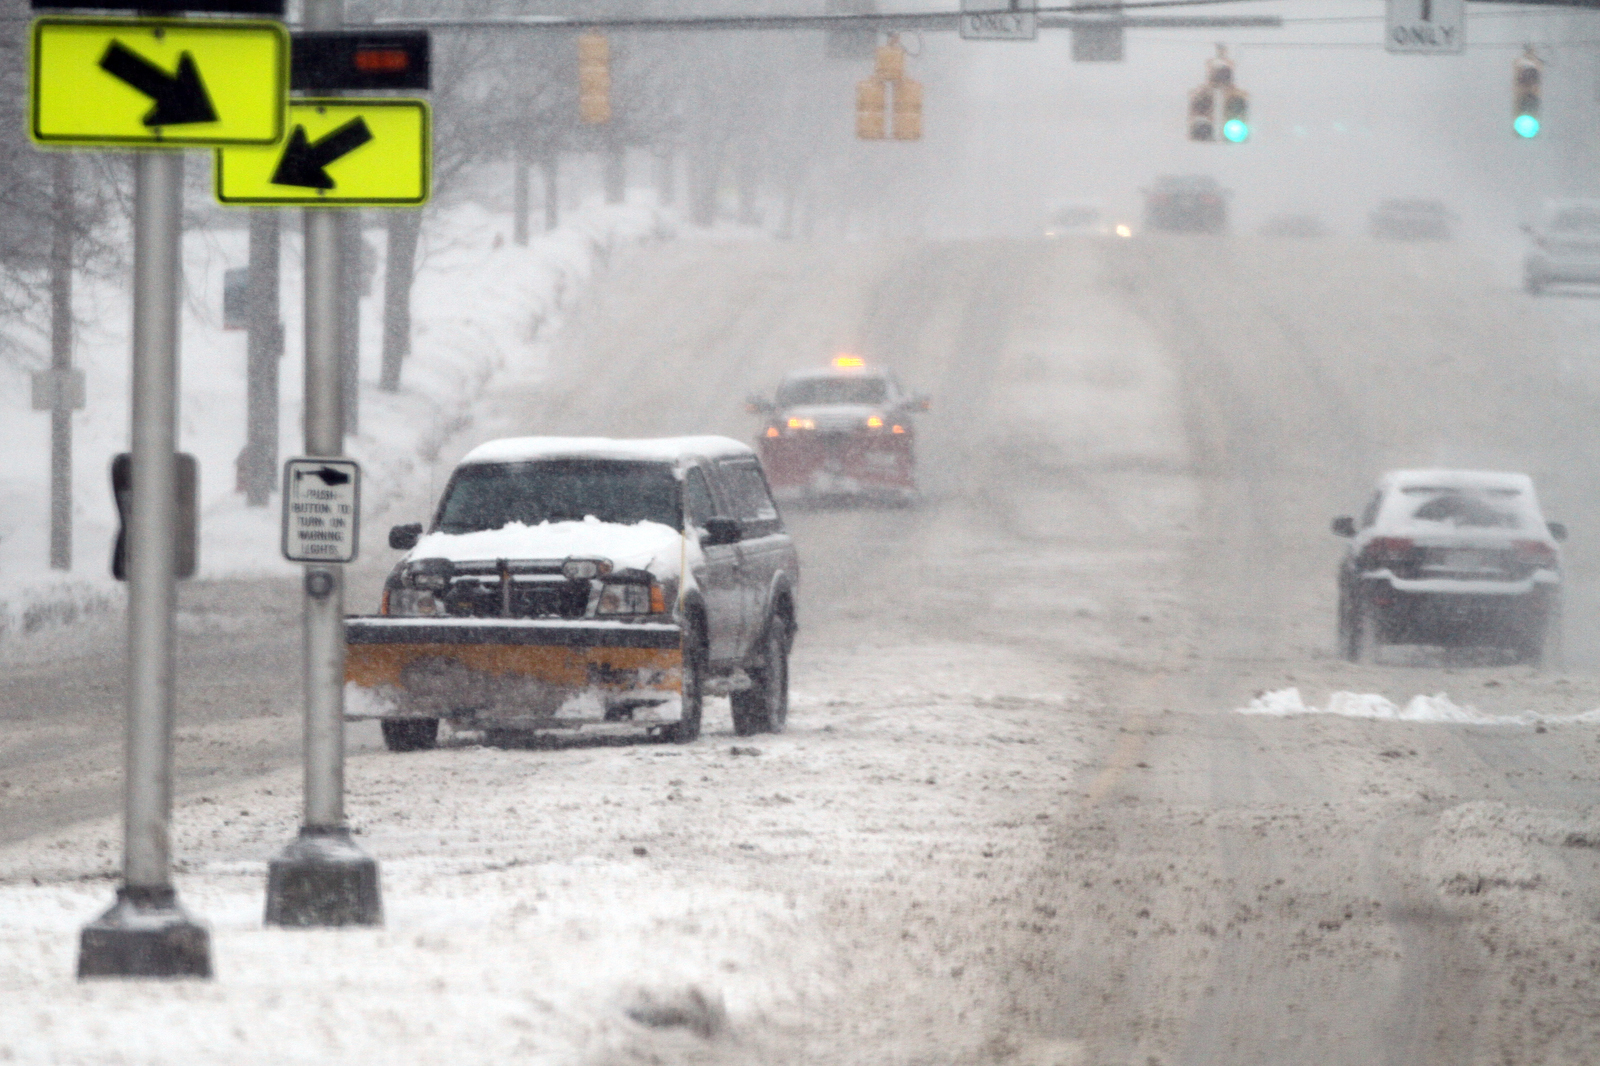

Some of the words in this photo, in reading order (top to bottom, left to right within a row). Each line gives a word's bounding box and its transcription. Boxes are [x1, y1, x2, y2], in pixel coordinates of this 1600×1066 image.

[970, 14, 1022, 33] ONLY
[1392, 25, 1454, 46] ONLY
[293, 503, 330, 513] BUTTON
[297, 517, 324, 527] TURN
[298, 531, 343, 541] WARNING
